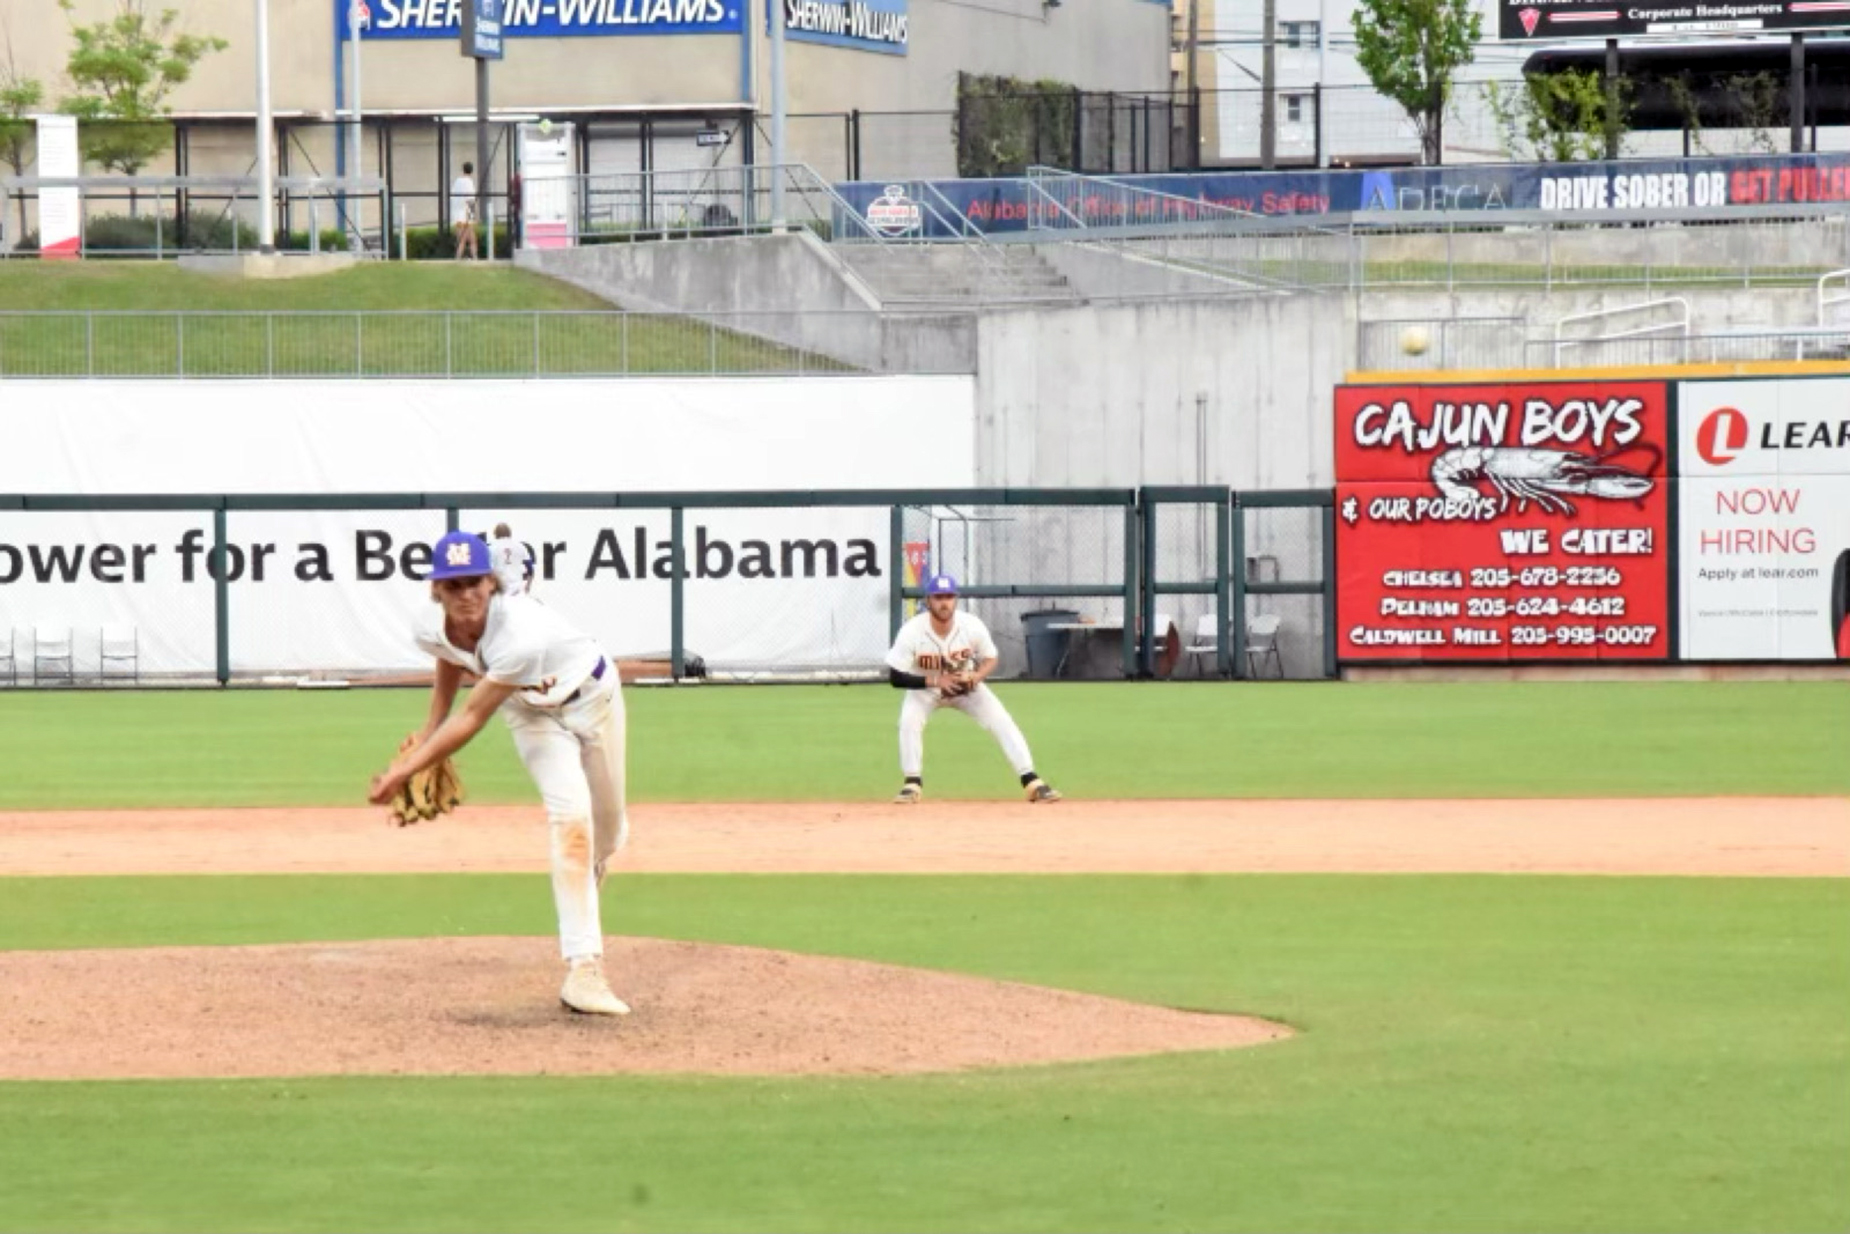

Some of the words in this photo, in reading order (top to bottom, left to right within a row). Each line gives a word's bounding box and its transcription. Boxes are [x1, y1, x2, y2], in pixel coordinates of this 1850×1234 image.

[377, 0, 724, 28] SHERIN-WILLIAMS
[1539, 177, 1608, 210] DRIVE
[1614, 173, 1689, 209] SOBER
[1694, 172, 1726, 207] OR
[1731, 168, 1771, 204] GET
[1354, 400, 1508, 452] CAJUN
[1521, 398, 1643, 446] BOYS
[1342, 497, 1358, 523] &
[1369, 497, 1412, 521] OUR
[1716, 488, 1801, 515] NOW
[175, 528, 276, 583] for
[294, 541, 334, 582] a
[585, 525, 882, 580] Alabama
[1500, 529, 1549, 554] WE
[1561, 528, 1653, 554] CATER!
[1701, 527, 1816, 555] HIRING
[1698, 567, 1737, 581] Apply
[1741, 568, 1755, 579] at
[1758, 567, 1819, 579] lear.com
[1467, 597, 1625, 616] 205-624-4612
